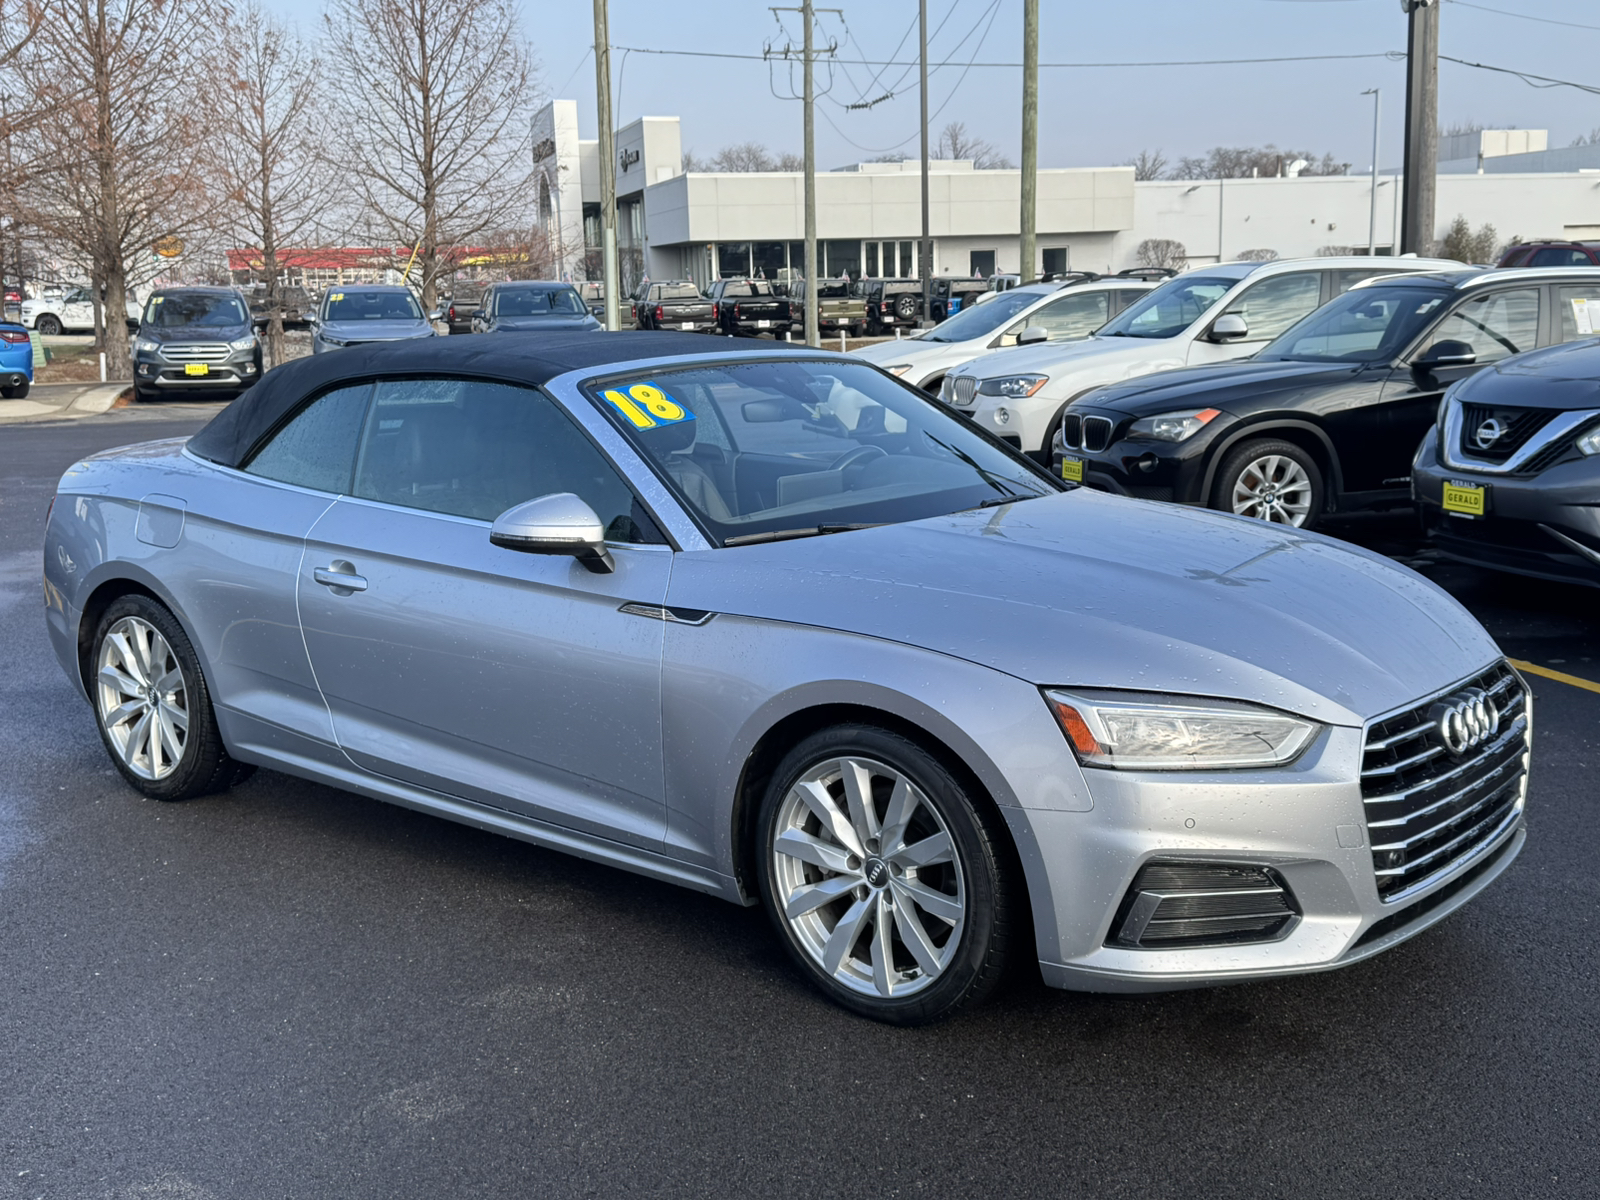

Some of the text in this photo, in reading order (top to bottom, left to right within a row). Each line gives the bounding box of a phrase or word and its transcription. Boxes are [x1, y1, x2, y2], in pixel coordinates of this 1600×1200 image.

[604, 384, 686, 428] 18
[1065, 466, 1080, 475] GERALD
[1451, 480, 1476, 488] GERALD
[1448, 493, 1479, 506] GERALD
